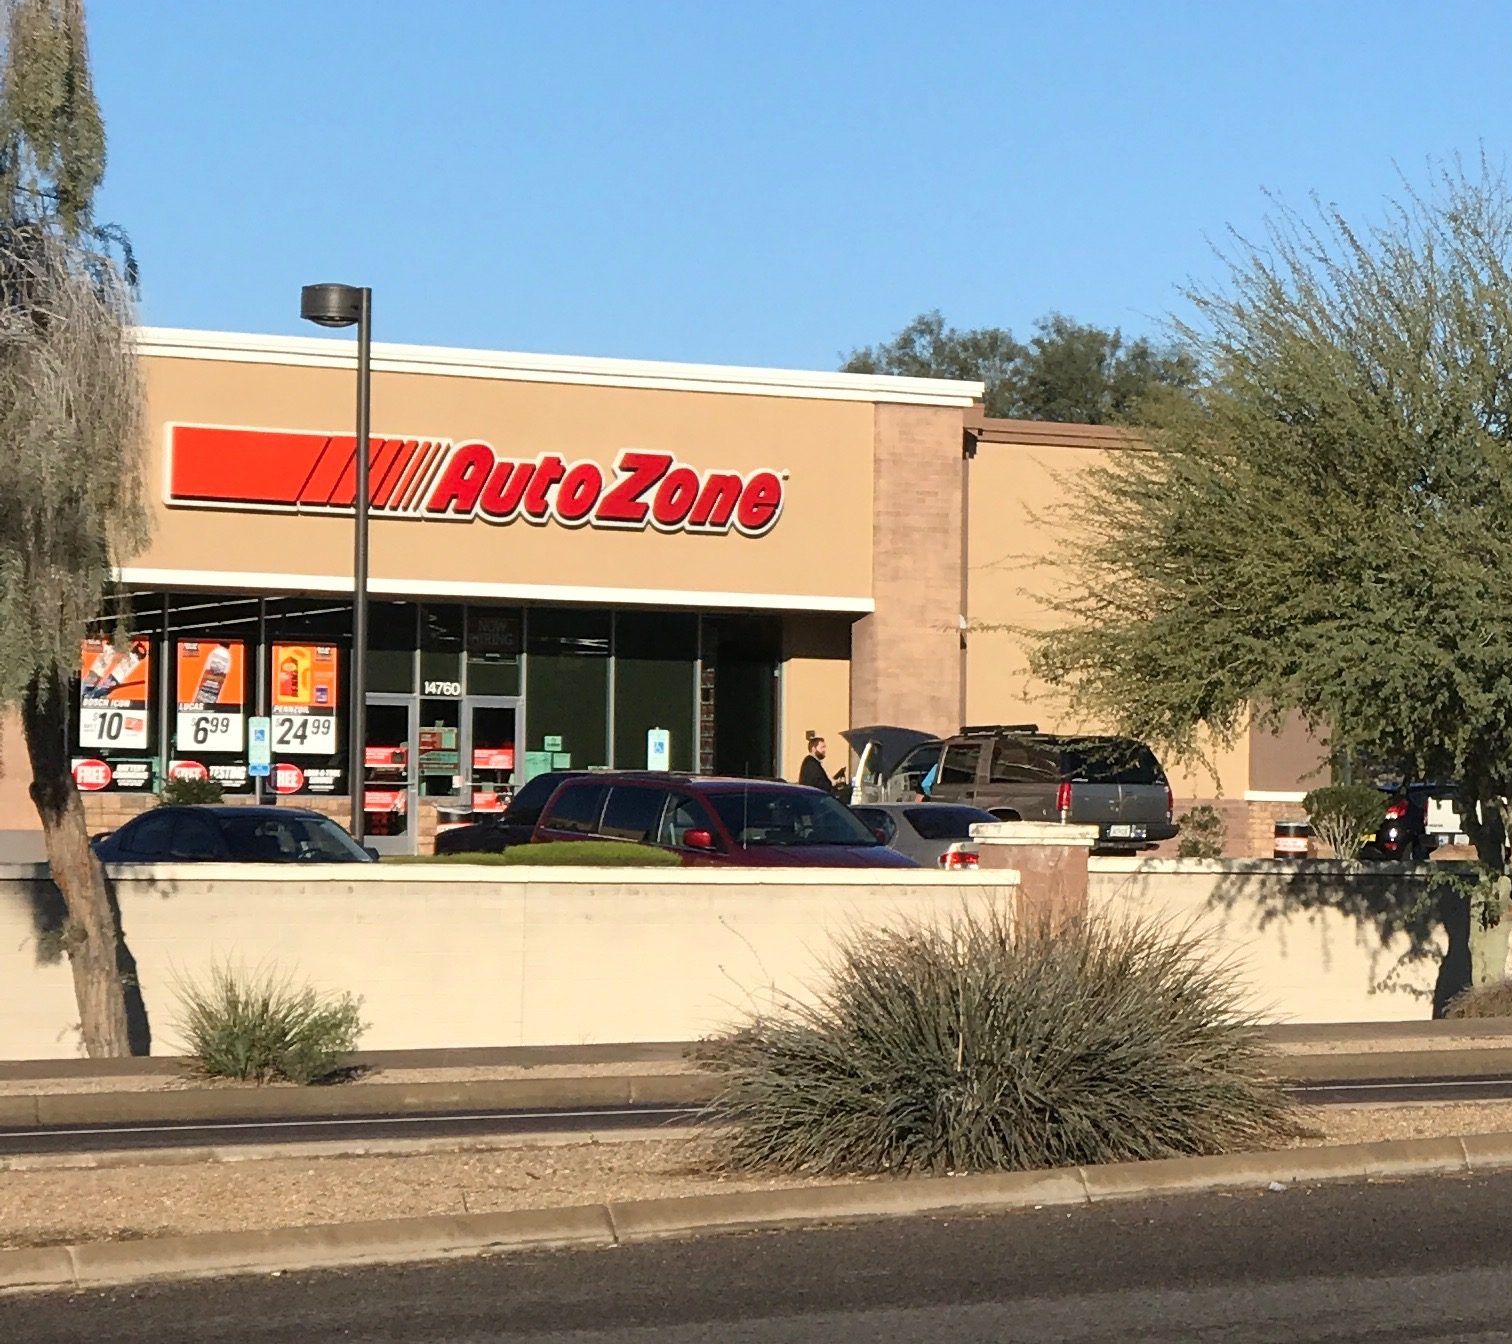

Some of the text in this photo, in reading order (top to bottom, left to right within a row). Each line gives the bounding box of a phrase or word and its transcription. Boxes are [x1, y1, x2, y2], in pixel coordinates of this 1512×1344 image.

[425, 442, 784, 532] AutoZone
[424, 681, 461, 696] 14760
[76, 765, 106, 784] FREE
